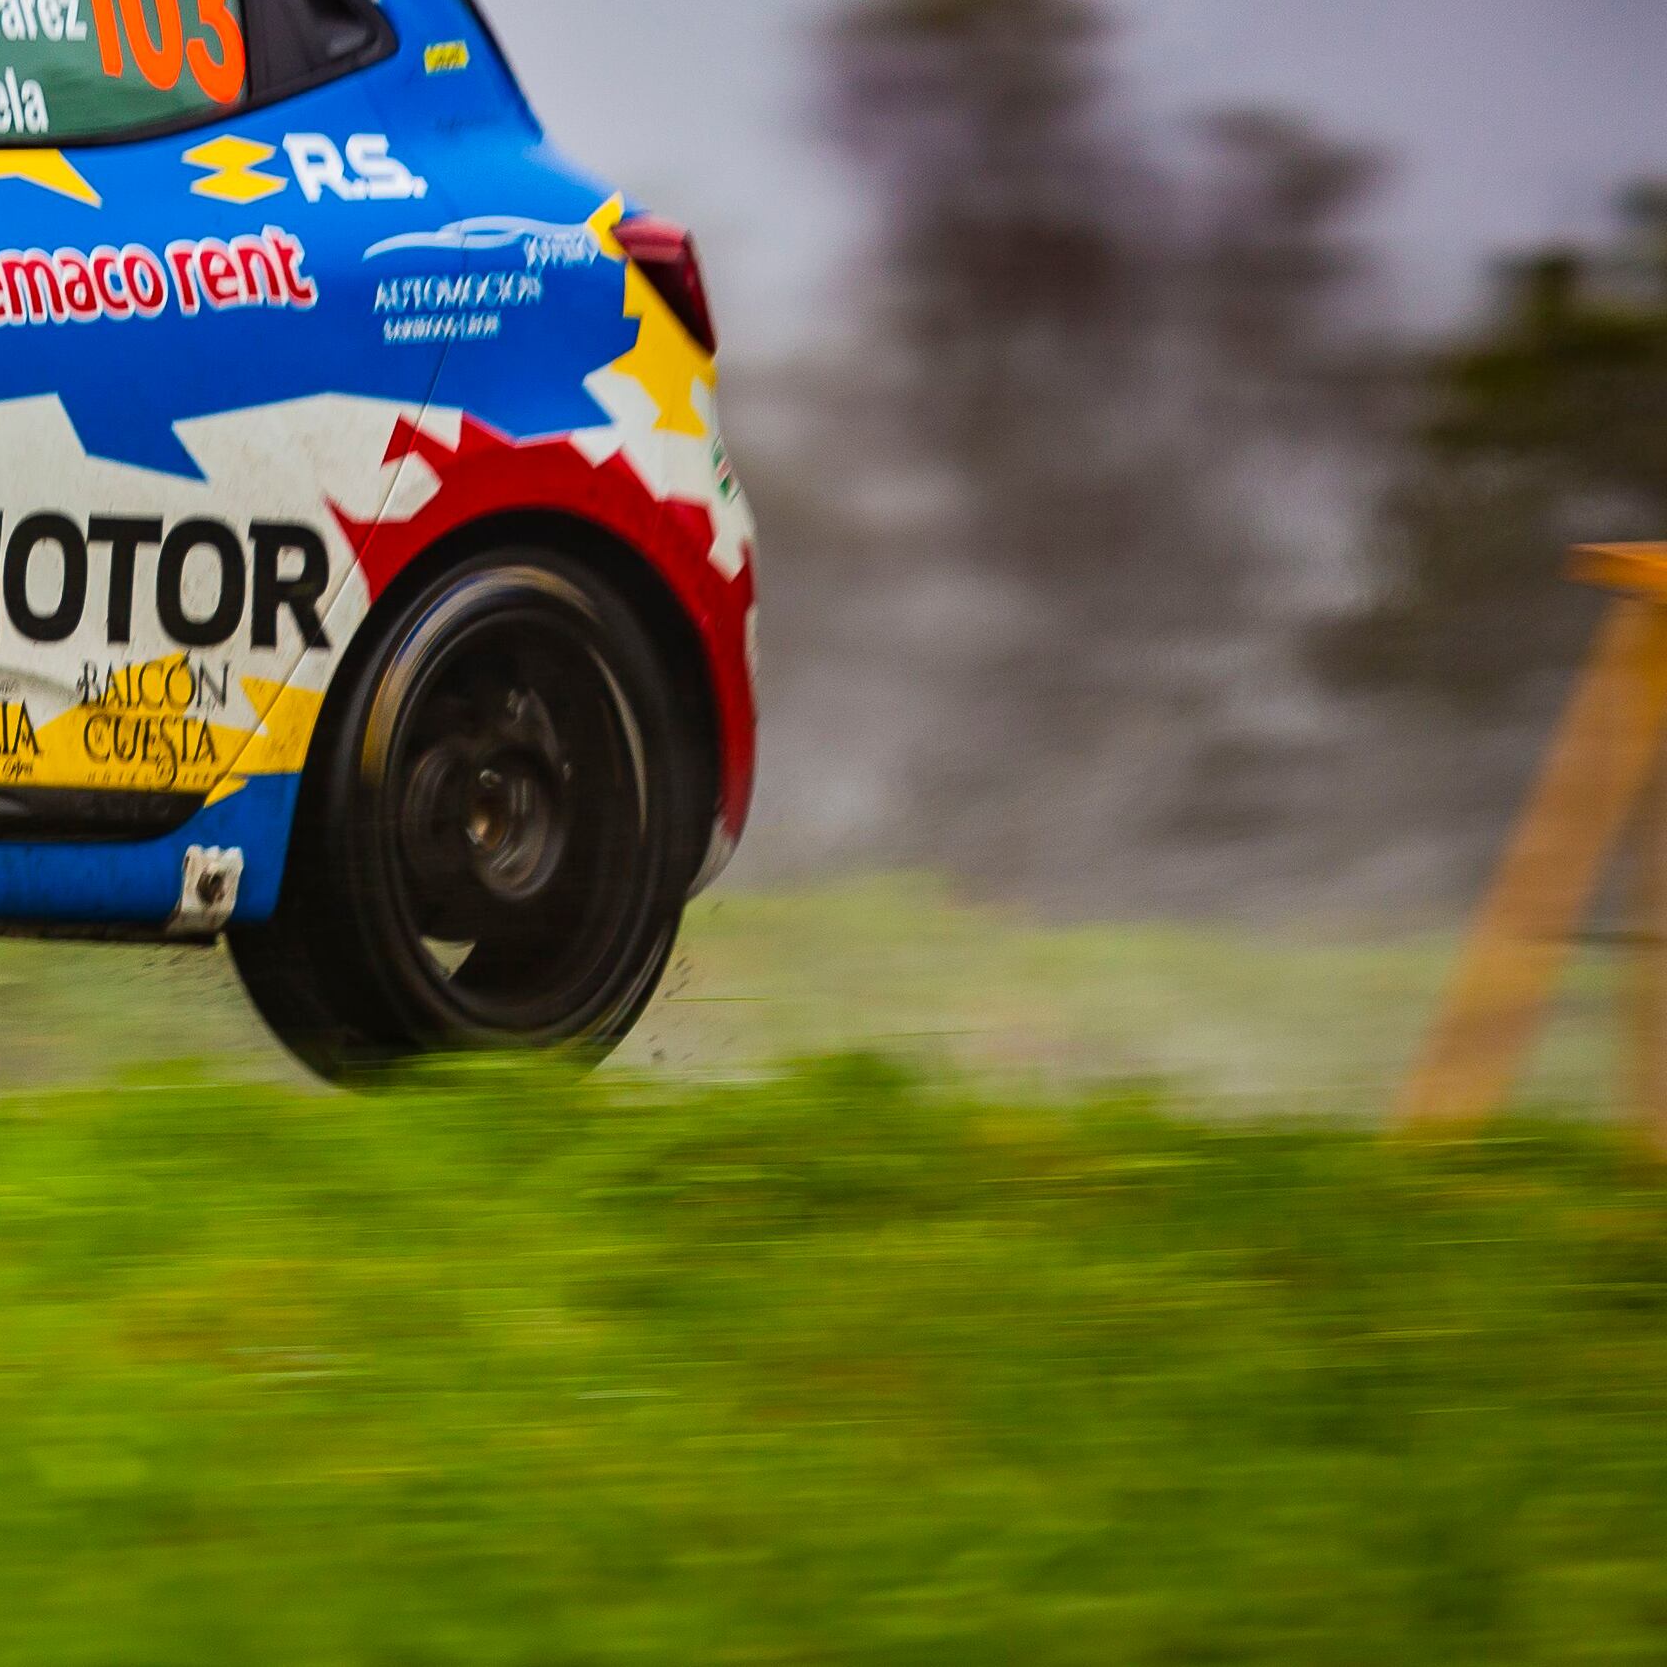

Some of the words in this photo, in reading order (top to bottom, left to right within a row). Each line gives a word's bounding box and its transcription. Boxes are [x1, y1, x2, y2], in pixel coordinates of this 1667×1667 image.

[283, 133, 429, 203] R.S.
[166, 224, 318, 317] rent
[78, 649, 230, 709] BALCÓN
[83, 713, 219, 784] CUESTA
